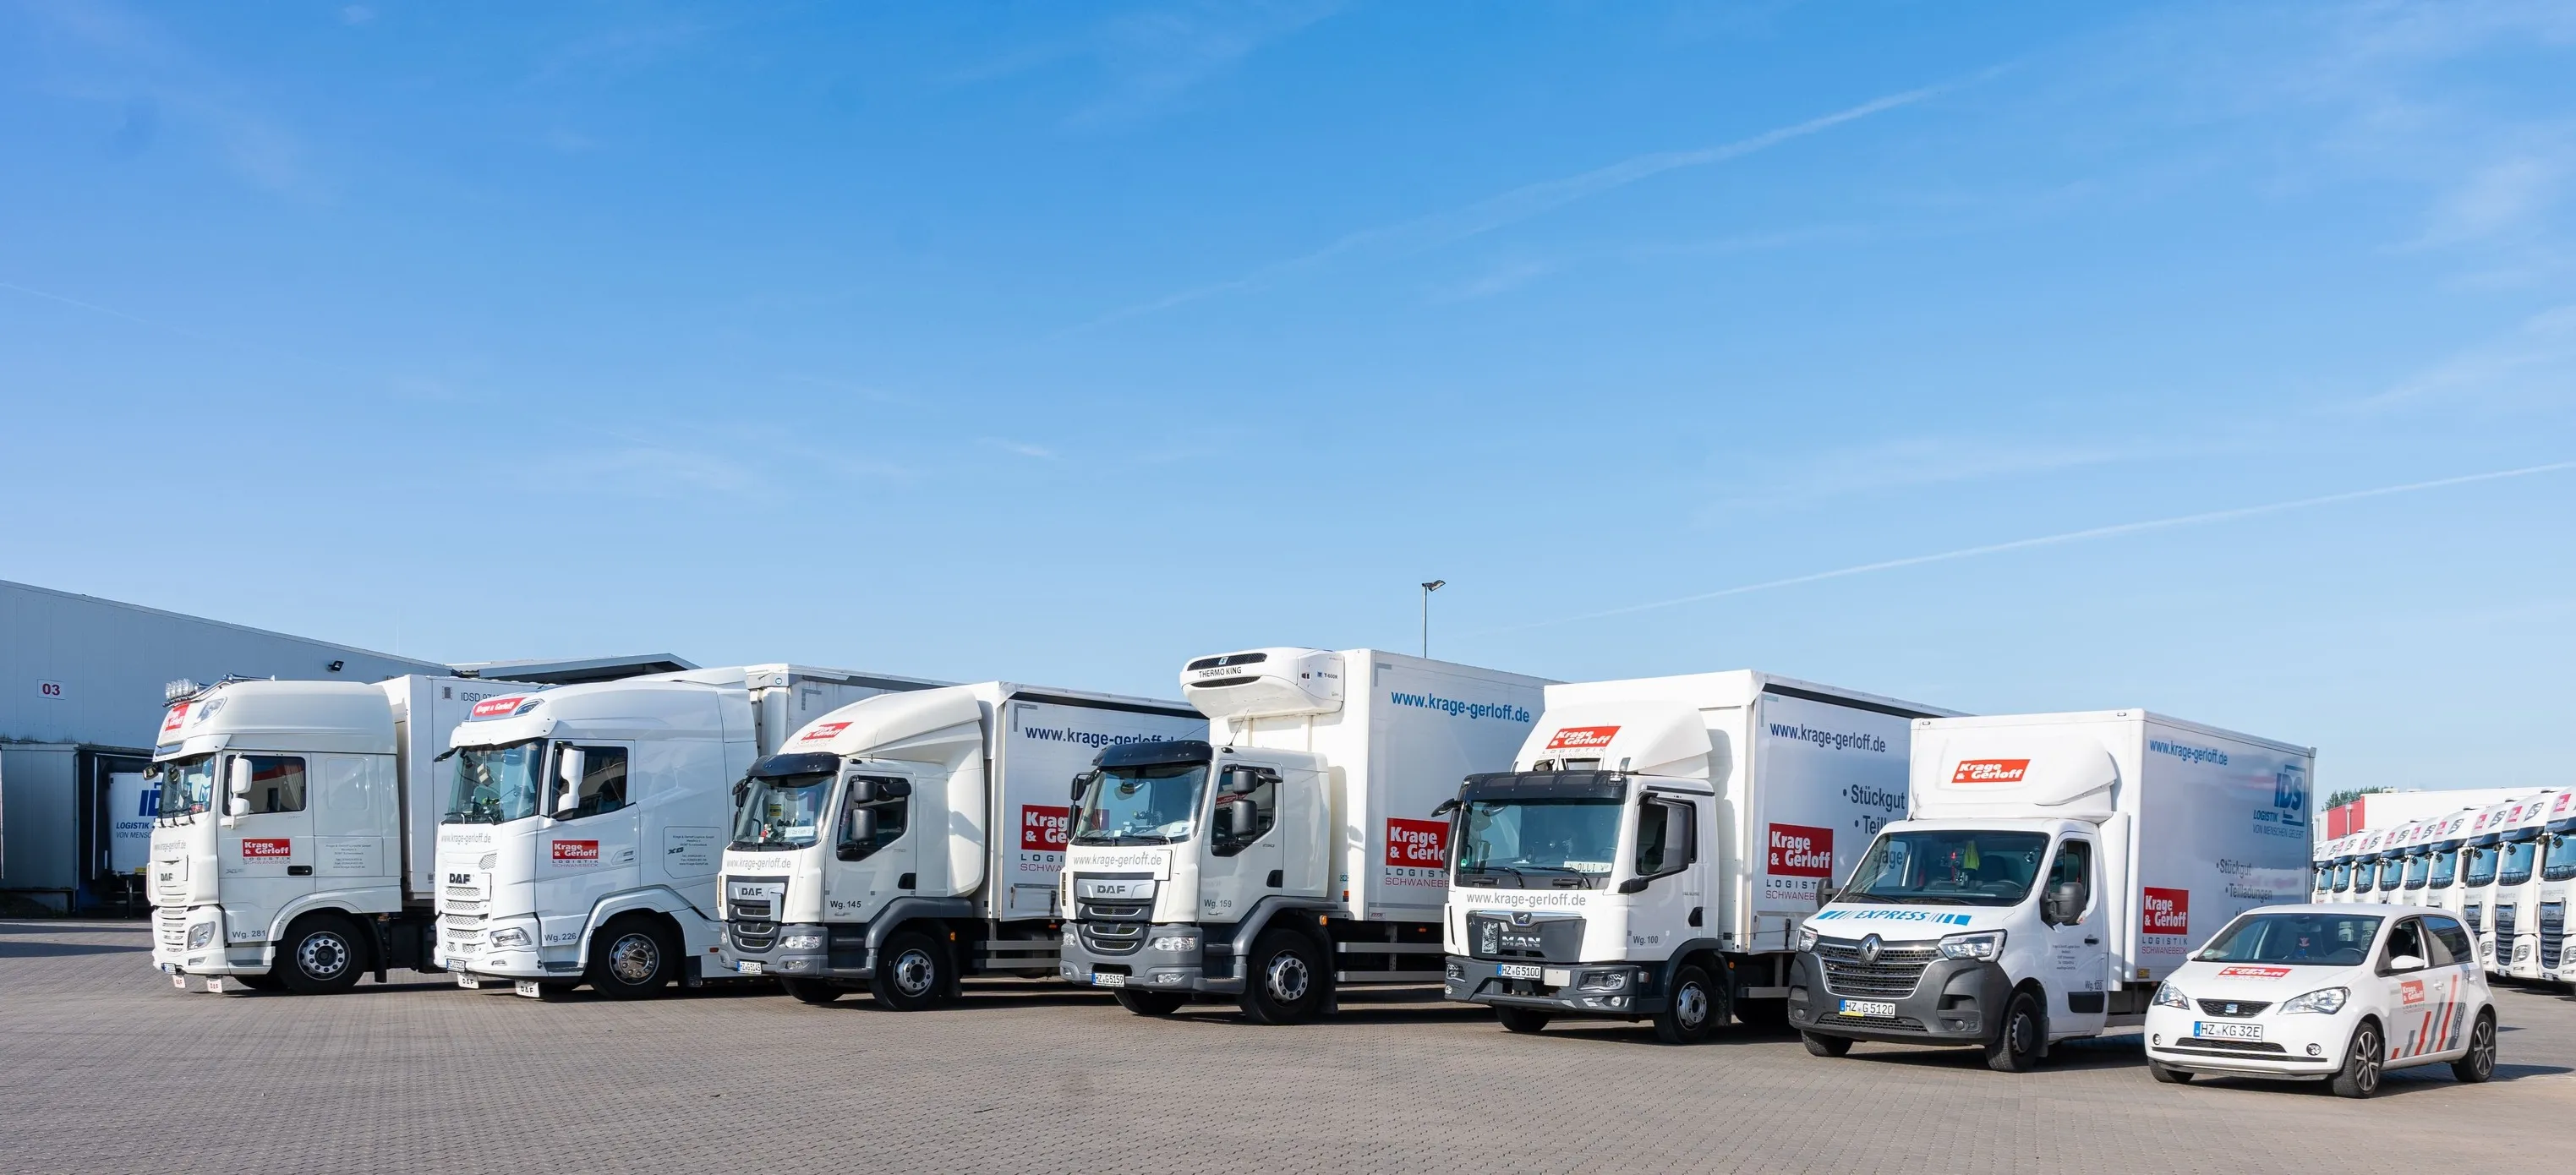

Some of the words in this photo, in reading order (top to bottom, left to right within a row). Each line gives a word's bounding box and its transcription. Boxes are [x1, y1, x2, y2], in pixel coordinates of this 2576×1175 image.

[1199, 668, 1225, 678] THERMO
[1226, 666, 1242, 675] KING
[42, 683, 61, 696] 03
[461, 691, 480, 702] IDSD
[1392, 691, 1529, 723] www.krage-gerloff.de
[1564, 735, 1611, 746] Gerloff
[1770, 723, 1885, 752] www.krage-gerloff.de
[2150, 739, 2228, 766] www.krage-gerloff.de
[1959, 763, 2002, 772] Krage
[1971, 768, 2023, 779] Gerloff
[2274, 773, 2303, 811] IDS
[1851, 784, 1905, 812] Stückgut
[2253, 810, 2278, 822] LOGISTIK
[1025, 812, 1068, 832] Krag
[441, 833, 491, 844] www.krage-gerloff.de
[1025, 830, 1036, 842] &
[1390, 826, 1437, 847] Krage
[244, 841, 274, 850] Krage
[1771, 831, 1810, 854] Krage
[255, 846, 289, 855] Gerloff
[1390, 846, 1400, 858] &
[1407, 844, 1445, 861] Gerlo
[727, 857, 791, 870] www.krage-gerloff.de
[1020, 854, 1063, 862] LOGI
[1073, 854, 1162, 867] www.krage-gerloff.de
[1770, 852, 1779, 866] &
[1785, 850, 1830, 868] Gerloff
[1386, 867, 1447, 878] LOGIST
[2220, 859, 2251, 878] Stückgut
[160, 872, 172, 882] DAF
[449, 873, 471, 884] DAF
[1385, 877, 1449, 888] SCHWANEBE
[1097, 885, 1125, 894] DAF
[1766, 879, 1817, 889] LOGIST
[741, 888, 763, 896] DAF
[1765, 890, 1817, 901] SCHWANEB
[2229, 883, 2272, 903] Teilladungen
[830, 901, 845, 910] Wg.
[1204, 899, 1217, 909] Wg.
[1220, 899, 1232, 908] 159
[1467, 893, 1586, 908] www.krage-gerloff.de
[2145, 895, 2173, 915] Krage
[1855, 910, 1930, 921] EXPRESS
[2145, 915, 2151, 926] &
[2155, 911, 2186, 927] Gerloff
[232, 931, 249, 939] Wg.
[544, 934, 561, 943] Wg.
[562, 932, 577, 941] 226
[1633, 935, 1646, 946] Wg.
[1648, 935, 1659, 944] 100
[1501, 936, 1540, 948] MAN
[2142, 937, 2188, 945] LOGISTIK
[2141, 946, 2188, 954] SCHWANEBECK
[2094, 981, 2103, 990] 120
[2201, 1024, 2215, 1035] HZ
[2222, 1025, 2236, 1036] KG
[2239, 1026, 2261, 1037] 32E
